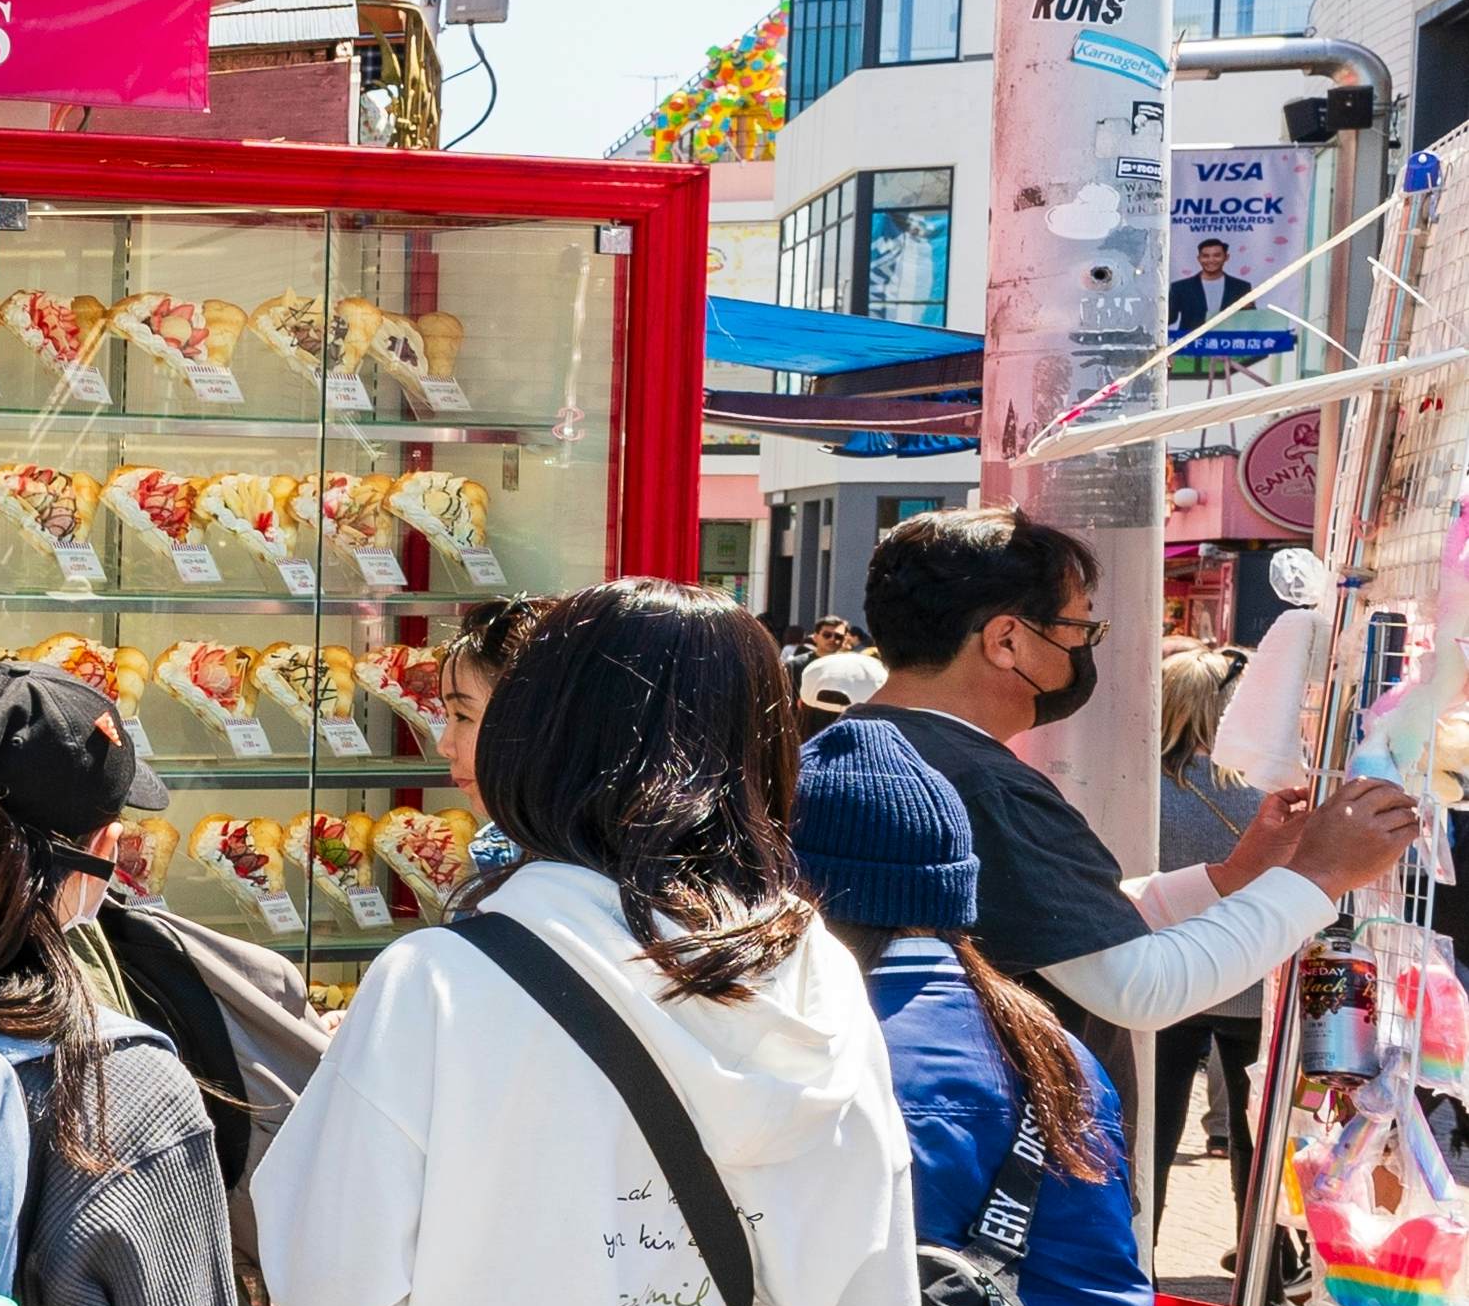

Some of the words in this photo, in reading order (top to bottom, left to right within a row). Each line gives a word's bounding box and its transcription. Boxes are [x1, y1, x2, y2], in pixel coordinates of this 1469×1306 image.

[1191, 162, 1264, 182] VISA
[1210, 216, 1274, 225] REWARDS
[1189, 224, 1224, 233] WITH
[1225, 224, 1254, 232] VISA
[1254, 464, 1317, 496] SANTA
